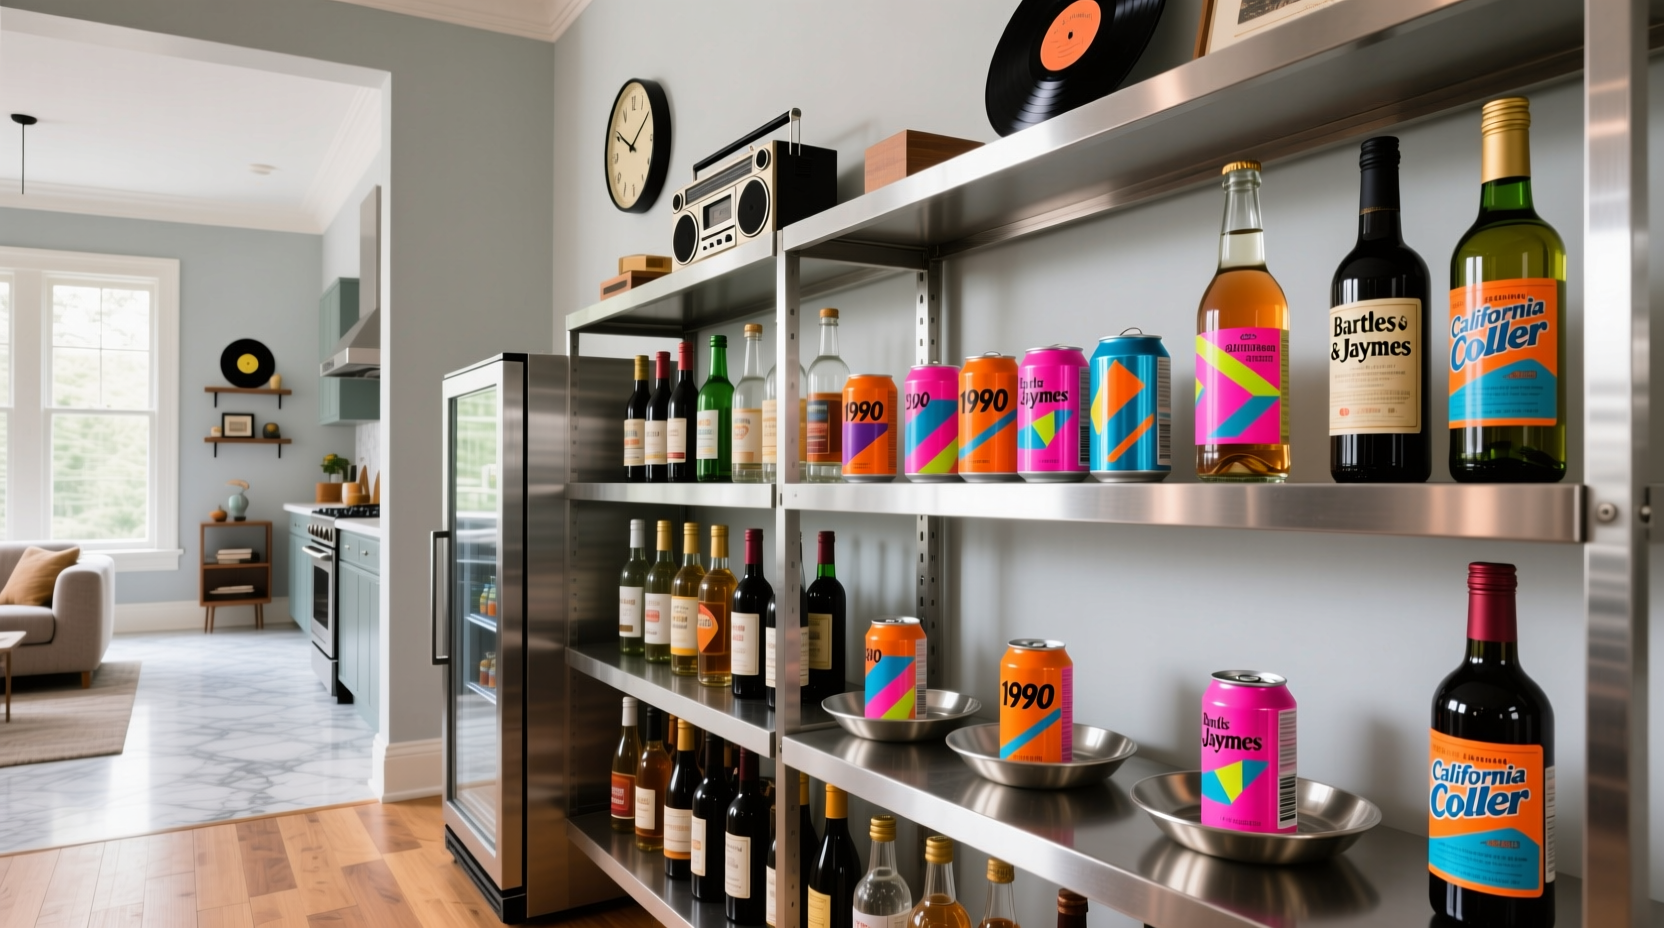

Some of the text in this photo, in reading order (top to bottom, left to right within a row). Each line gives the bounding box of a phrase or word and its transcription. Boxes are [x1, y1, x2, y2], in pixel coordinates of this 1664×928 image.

[1334, 311, 1396, 337] Bartles
[1452, 297, 1544, 339] California
[1331, 338, 1411, 363] & Jaymes
[1451, 321, 1548, 371] Coller
[844, 401, 884, 422] 1990
[960, 388, 1009, 414] 1990
[1002, 680, 1055, 709] 1990
[1202, 728, 1262, 753] Jaymes
[1432, 760, 1526, 785] California
[1430, 783, 1530, 818] Coller
